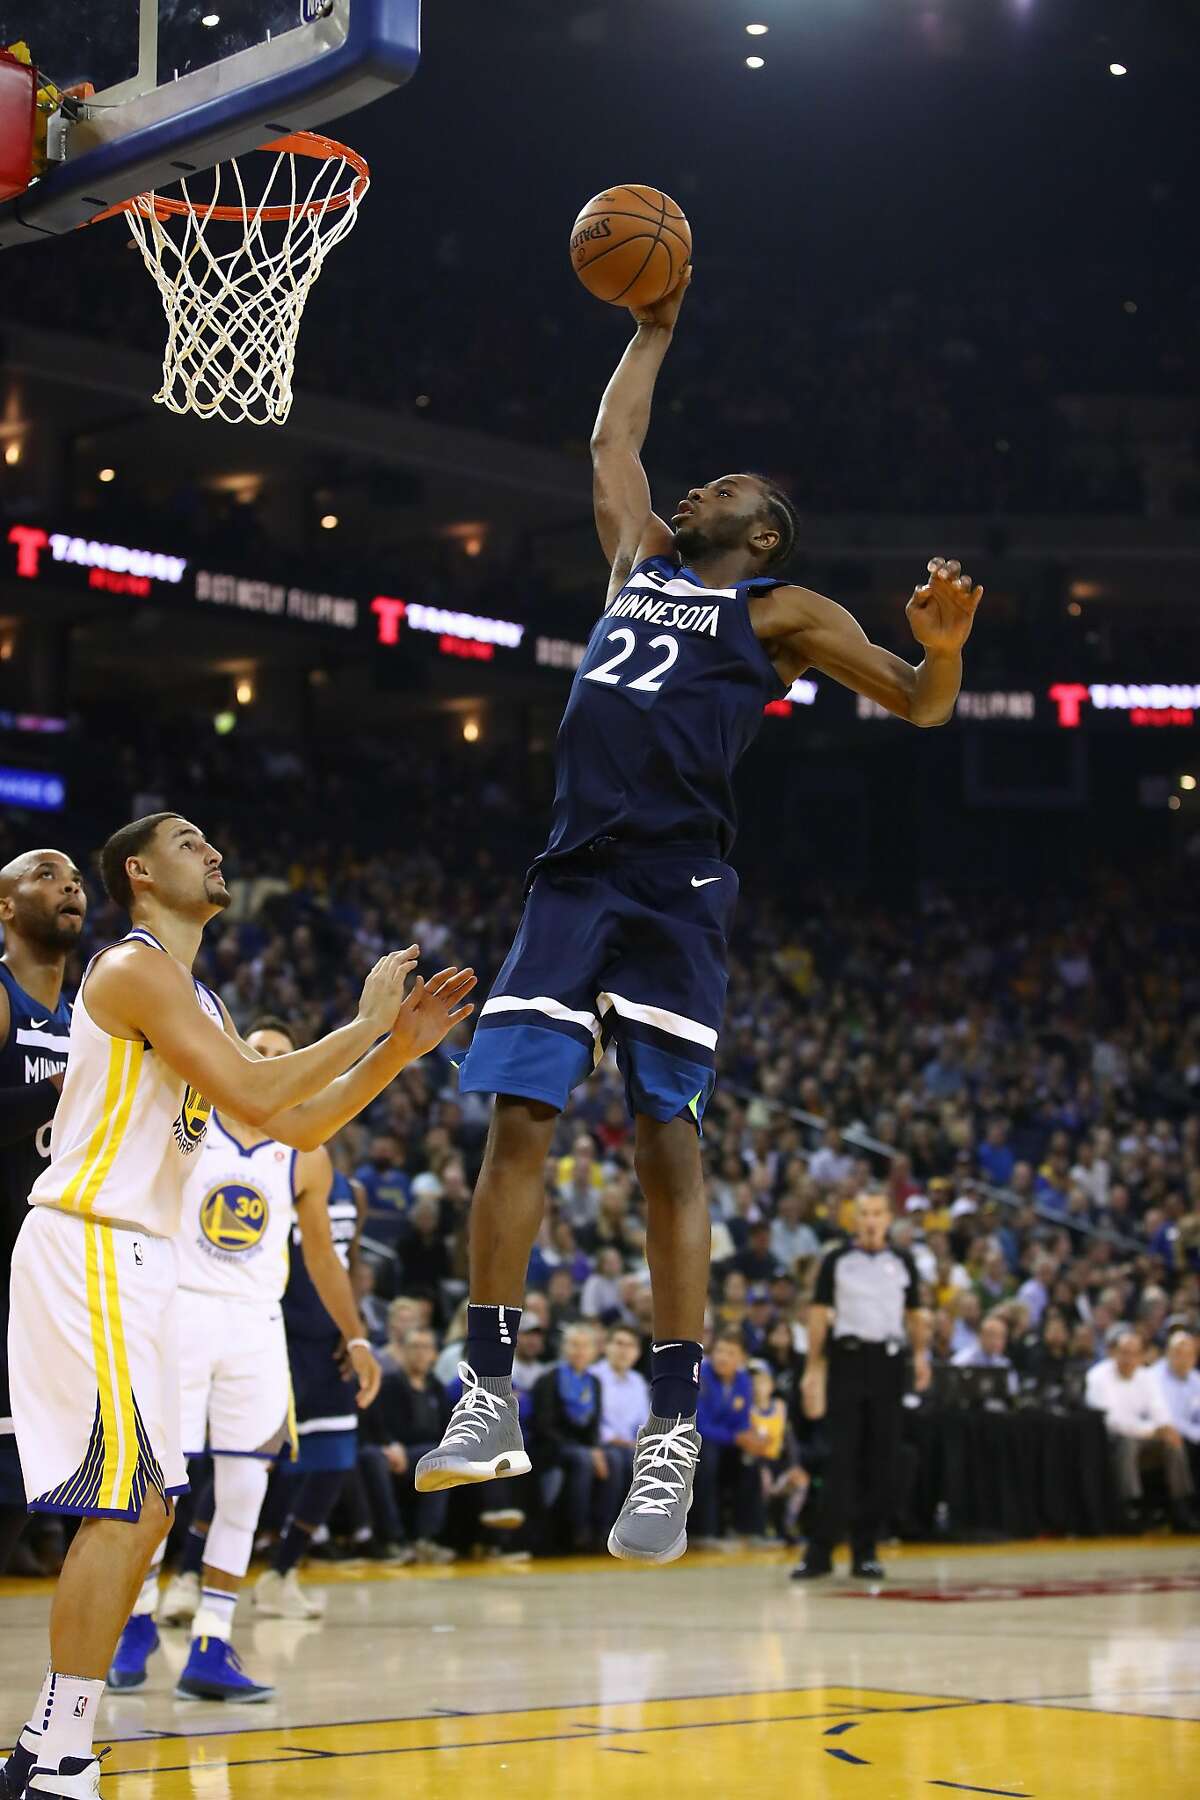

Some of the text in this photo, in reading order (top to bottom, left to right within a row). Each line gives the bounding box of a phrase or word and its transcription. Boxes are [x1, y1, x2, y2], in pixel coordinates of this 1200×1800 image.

[605, 592, 720, 638] MINNESOTA
[582, 627, 679, 692] 22
[234, 1196, 263, 1220] 30
